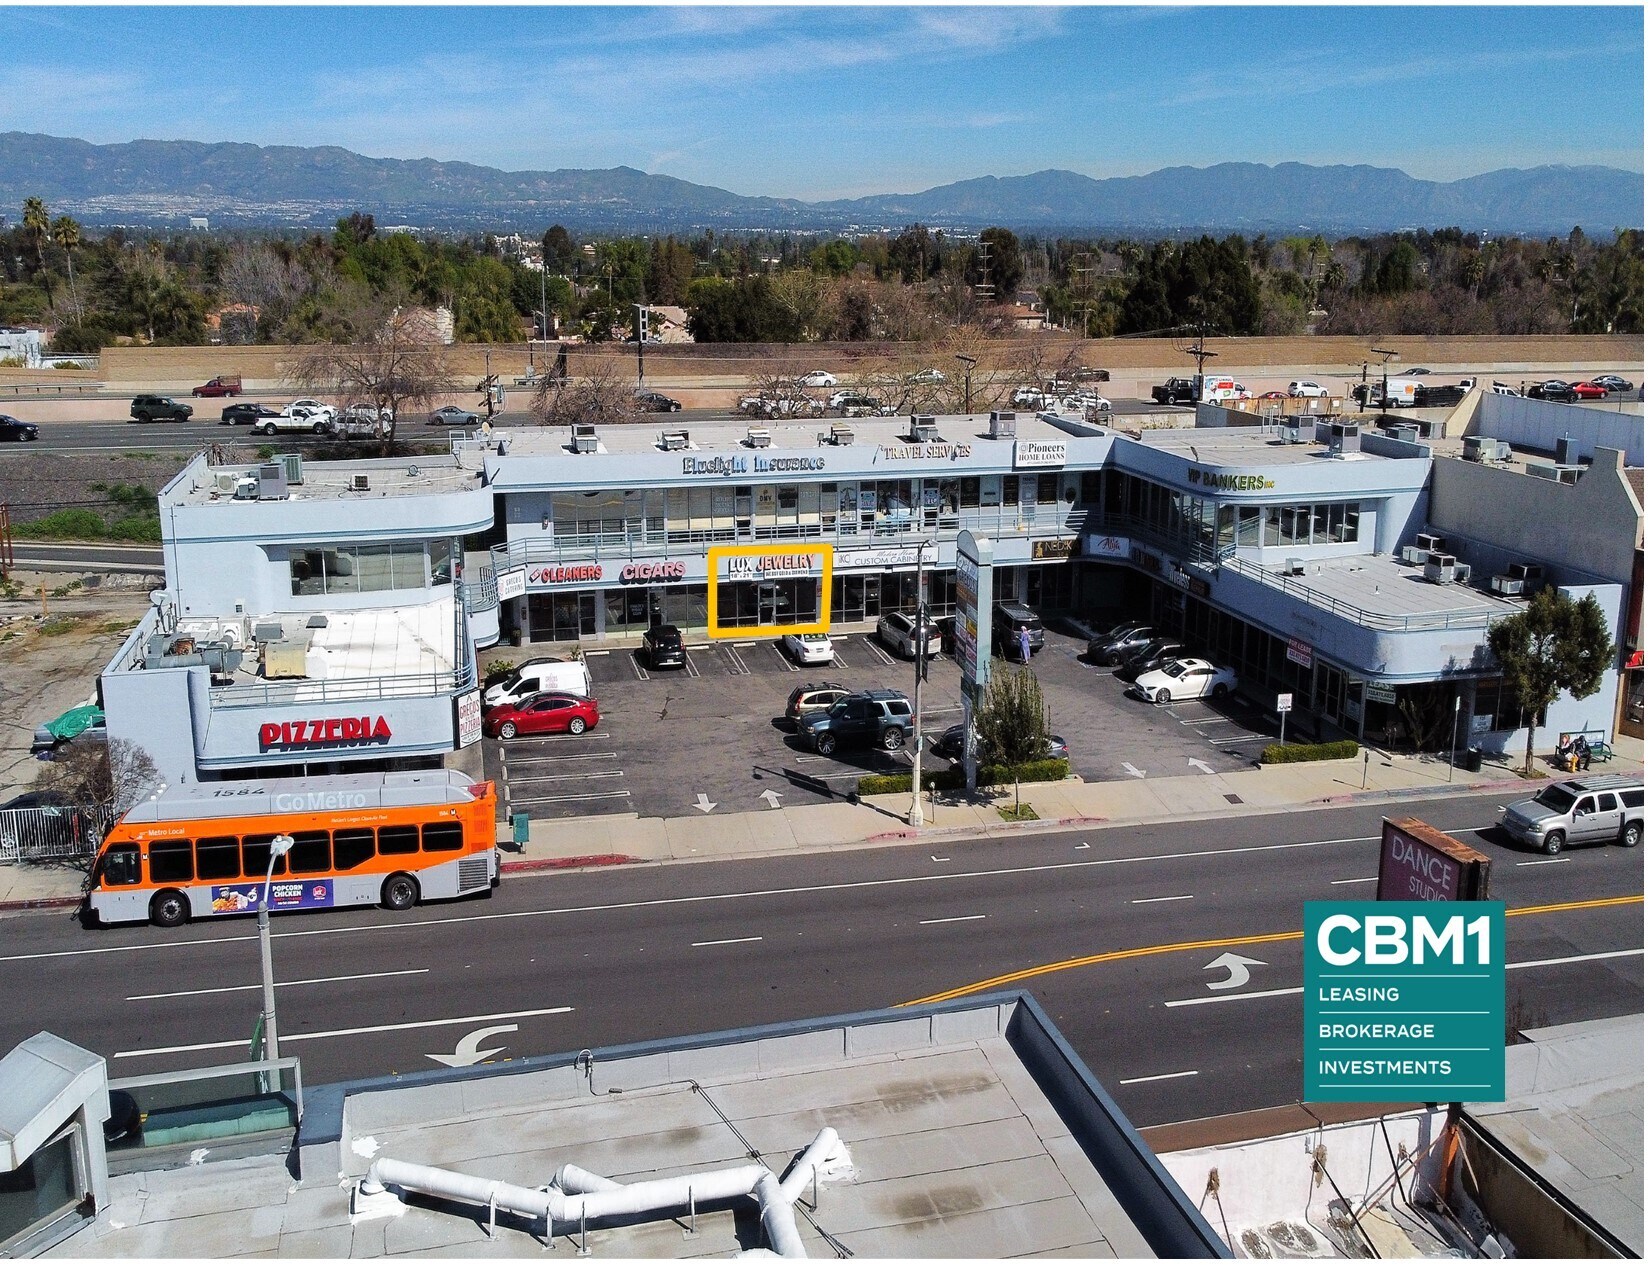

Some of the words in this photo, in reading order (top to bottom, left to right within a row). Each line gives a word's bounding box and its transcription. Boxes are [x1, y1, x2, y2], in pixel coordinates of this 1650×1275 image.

[885, 444, 924, 460] TRAVEL
[1028, 443, 1065, 453] Pioneers
[753, 455, 826, 473] Insurance
[1019, 453, 1040, 462] HOME
[1041, 453, 1065, 461] LOANS
[1188, 467, 1200, 485] VIP
[1203, 472, 1264, 491] BANKERS
[728, 557, 753, 573] LUX
[756, 554, 815, 572] JEWELRY
[855, 557, 889, 565] CUSTOM
[891, 554, 932, 563] CABINERY
[541, 565, 602, 583] CLEANERS
[621, 561, 686, 585] CIGARS
[1298, 643, 1312, 655] LEASE
[259, 715, 392, 752] PIZZERIA
[460, 716, 480, 734] PIZZERIA
[213, 787, 265, 798] 1584
[276, 793, 304, 812] Go
[307, 790, 366, 811] Metro
[148, 829, 167, 837] Metro
[168, 828, 185, 836] Local
[1391, 836, 1452, 891] DANCE
[272, 884, 303, 892] POPCORN
[274, 890, 302, 898] CHICKEN
